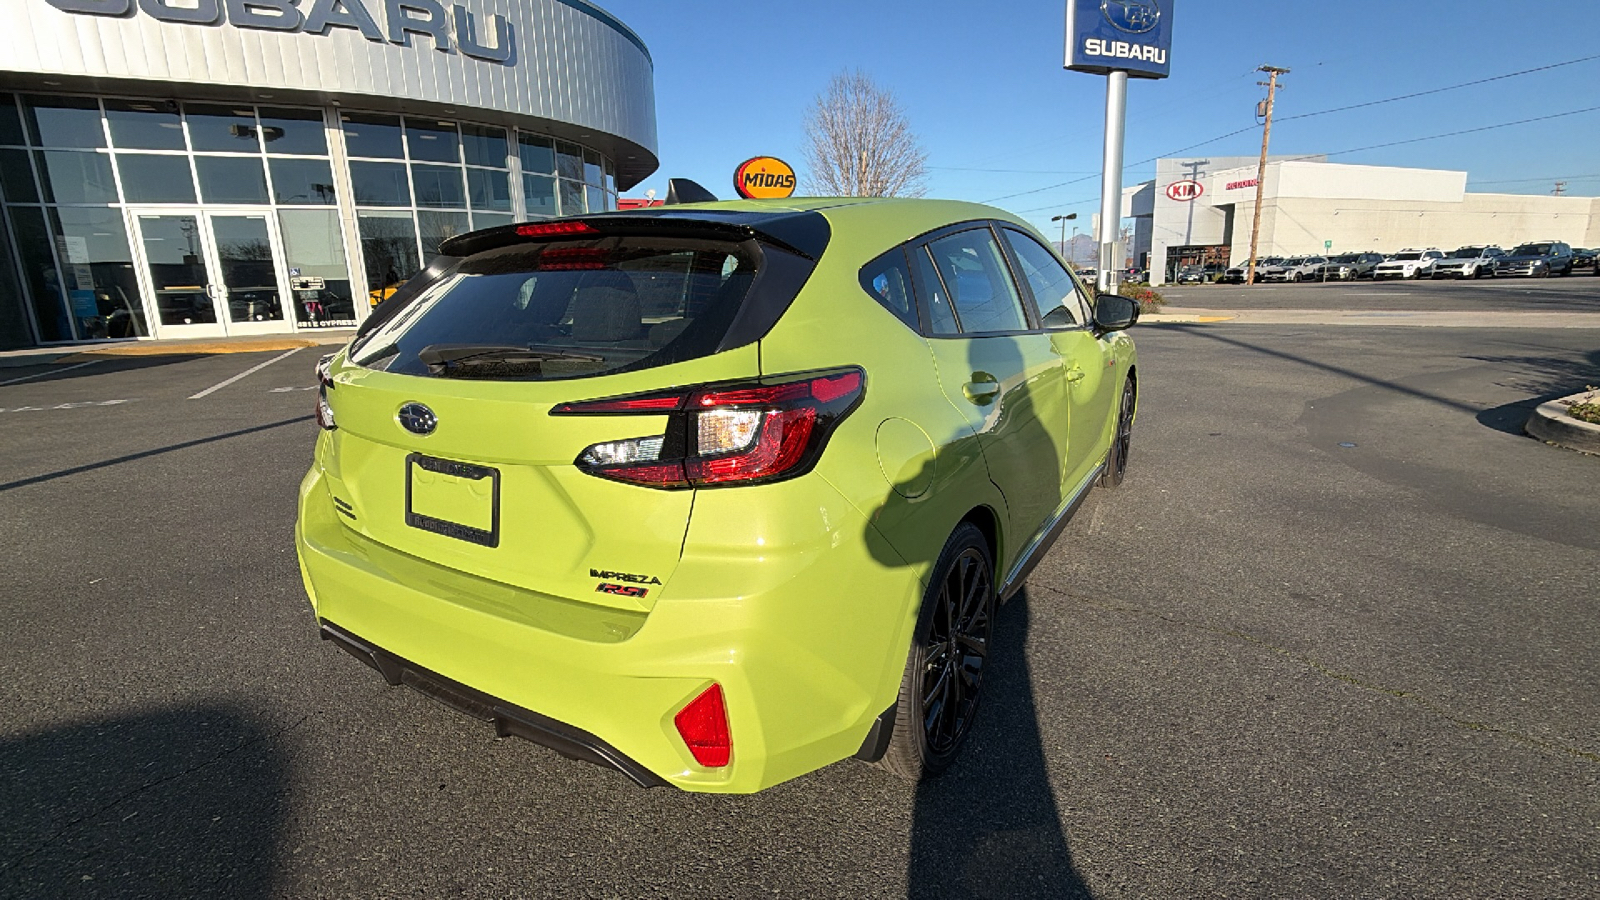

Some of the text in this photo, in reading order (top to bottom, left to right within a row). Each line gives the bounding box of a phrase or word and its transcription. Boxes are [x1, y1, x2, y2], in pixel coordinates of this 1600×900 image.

[44, 0, 510, 62] BARU
[1085, 38, 1166, 64] SUBARU
[1172, 185, 1197, 197] KIA
[589, 568, 662, 585] IMPREZA
